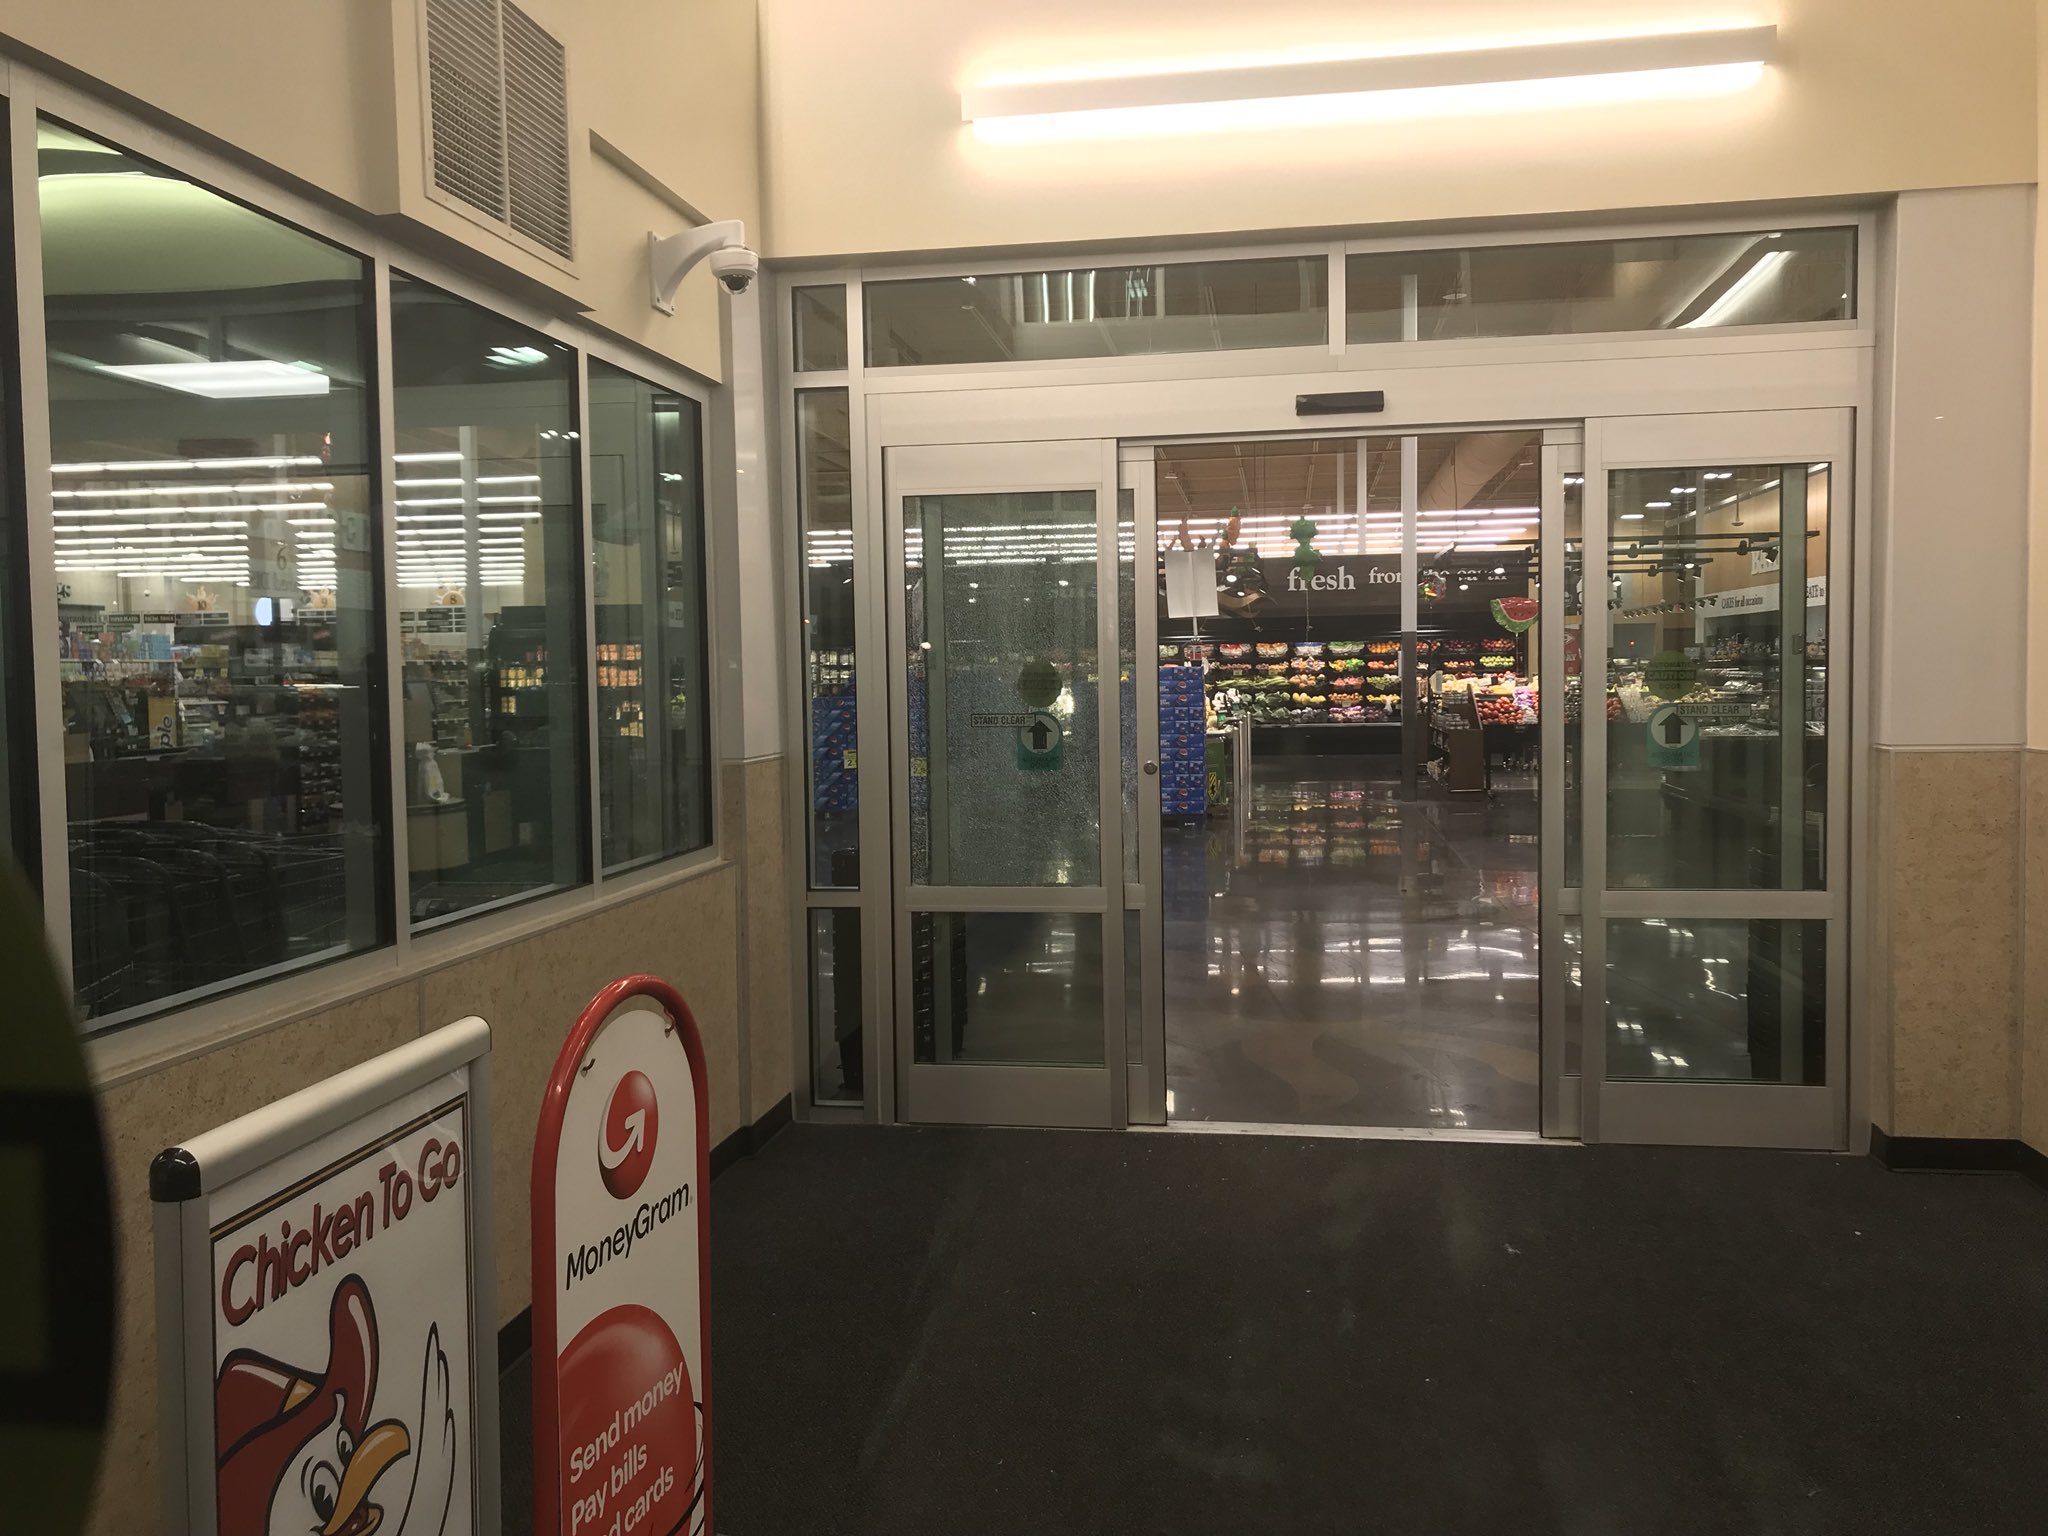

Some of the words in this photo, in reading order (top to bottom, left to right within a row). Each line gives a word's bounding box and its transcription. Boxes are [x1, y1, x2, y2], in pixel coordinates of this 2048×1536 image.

[277, 545, 288, 570] 6
[1287, 565, 1356, 592] fresh
[1369, 566, 1402, 584] fro
[197, 600, 207, 610] 10
[321, 597, 328, 608] 9
[450, 594, 457, 604] 8
[1648, 671, 1696, 680] CAUTION
[973, 715, 998, 725] STAND
[1001, 715, 1026, 725] CLEAR
[1679, 705, 1708, 715] STAND
[1711, 704, 1740, 715] CLEAR
[157, 716, 173, 748] ple
[221, 1190, 374, 1327] Chicken
[378, 1160, 413, 1229] To
[418, 1137, 461, 1204] Go
[565, 1183, 689, 1291] MoneyGram
[570, 1410, 621, 1484] Send
[623, 1361, 684, 1435] money
[571, 1480, 608, 1536] Pay
[611, 1444, 648, 1498] bills
[624, 1466, 674, 1533] cards
